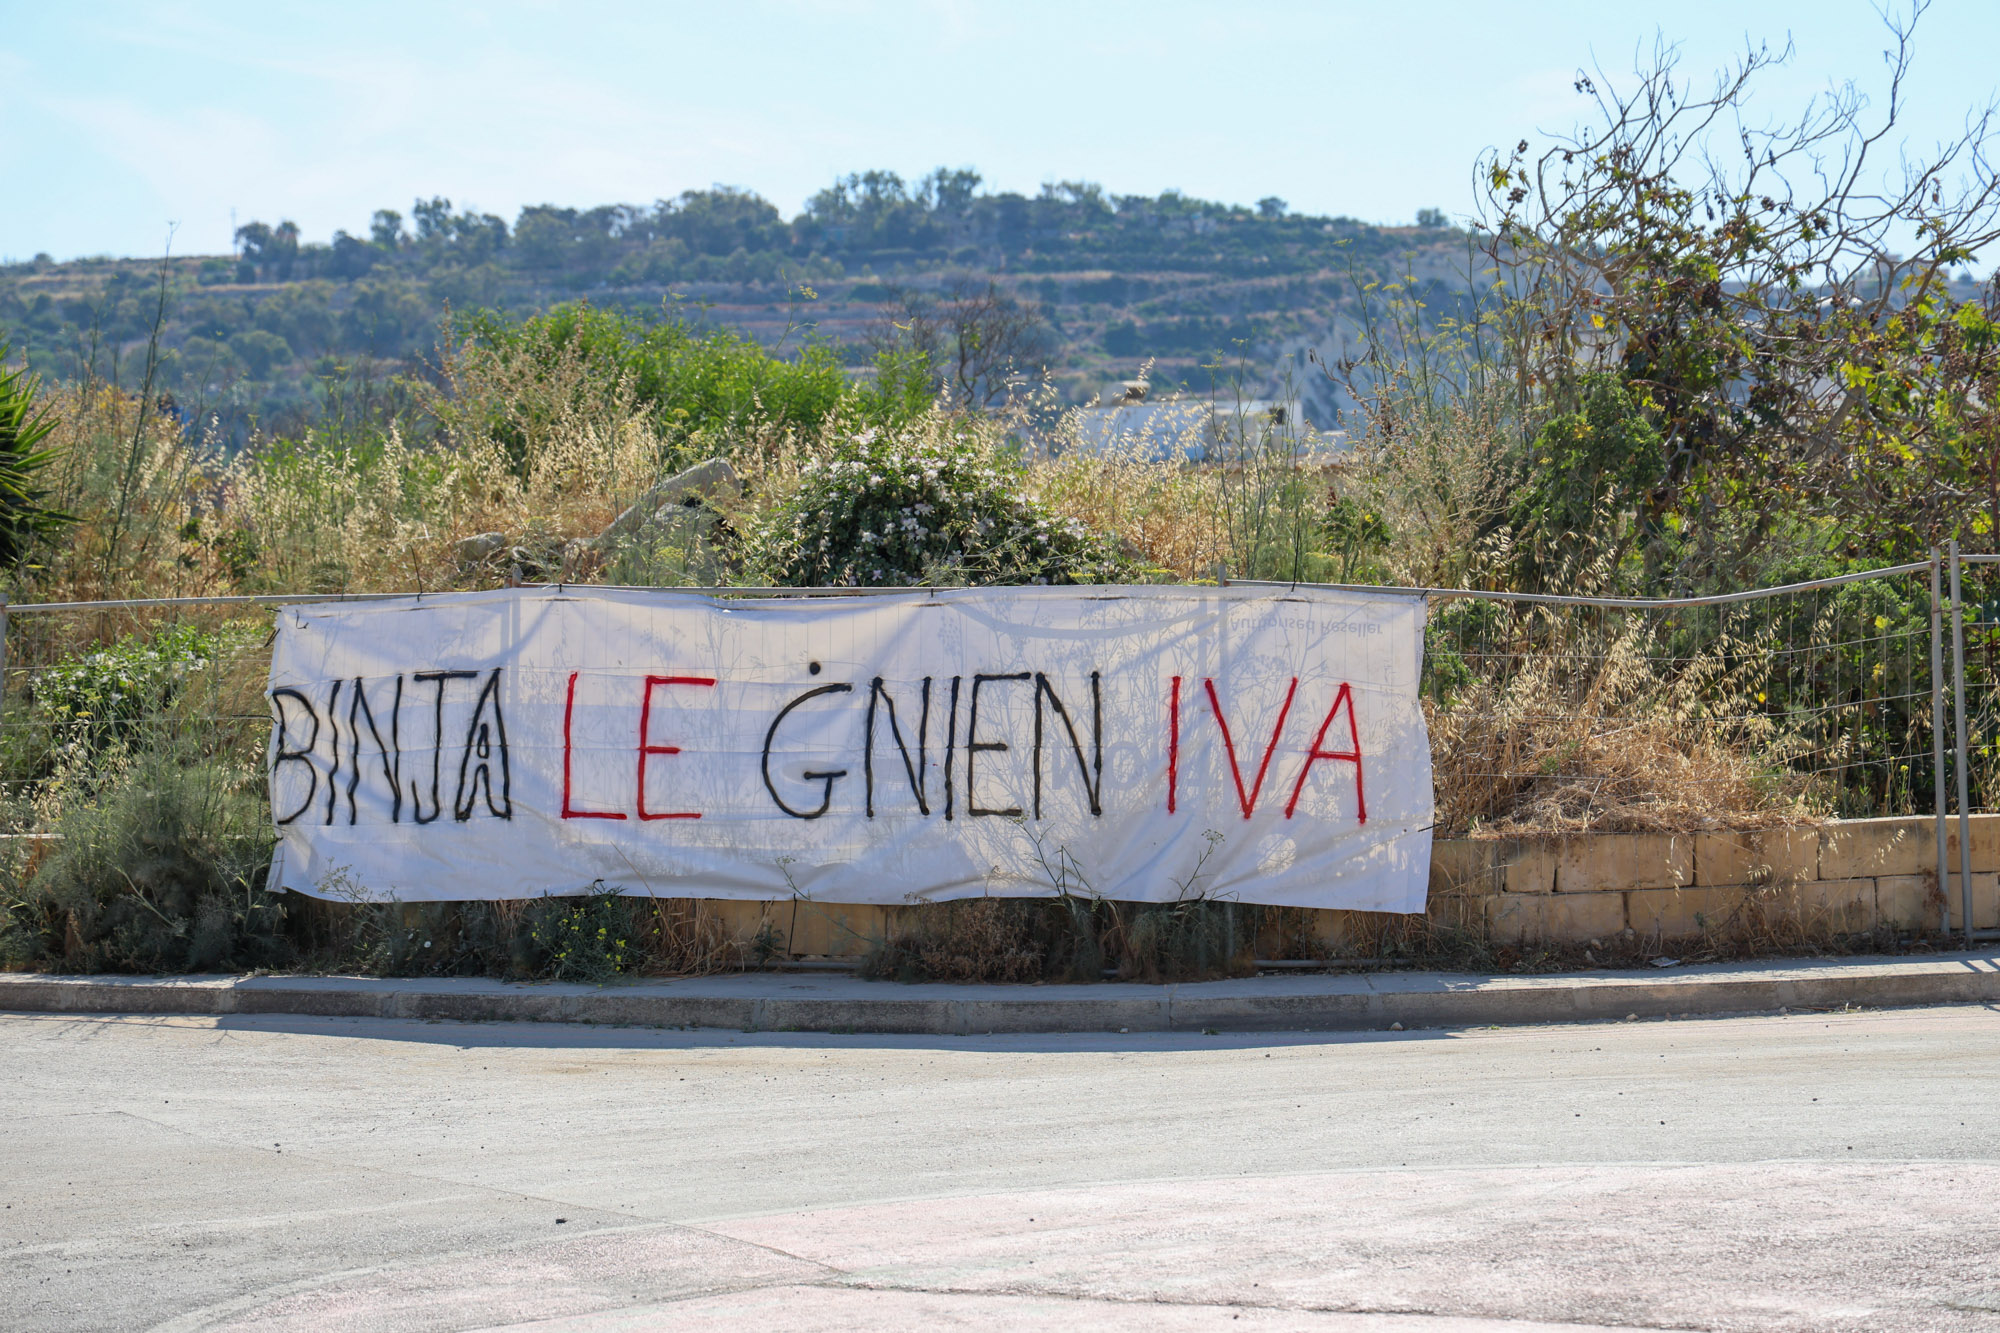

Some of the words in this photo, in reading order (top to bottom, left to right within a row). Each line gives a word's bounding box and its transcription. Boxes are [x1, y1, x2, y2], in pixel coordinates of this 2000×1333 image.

[272, 667, 511, 826] BINJA
[560, 671, 717, 822] LE
[761, 660, 1102, 821] ĠNIEN
[1168, 675, 1367, 824] IVA
